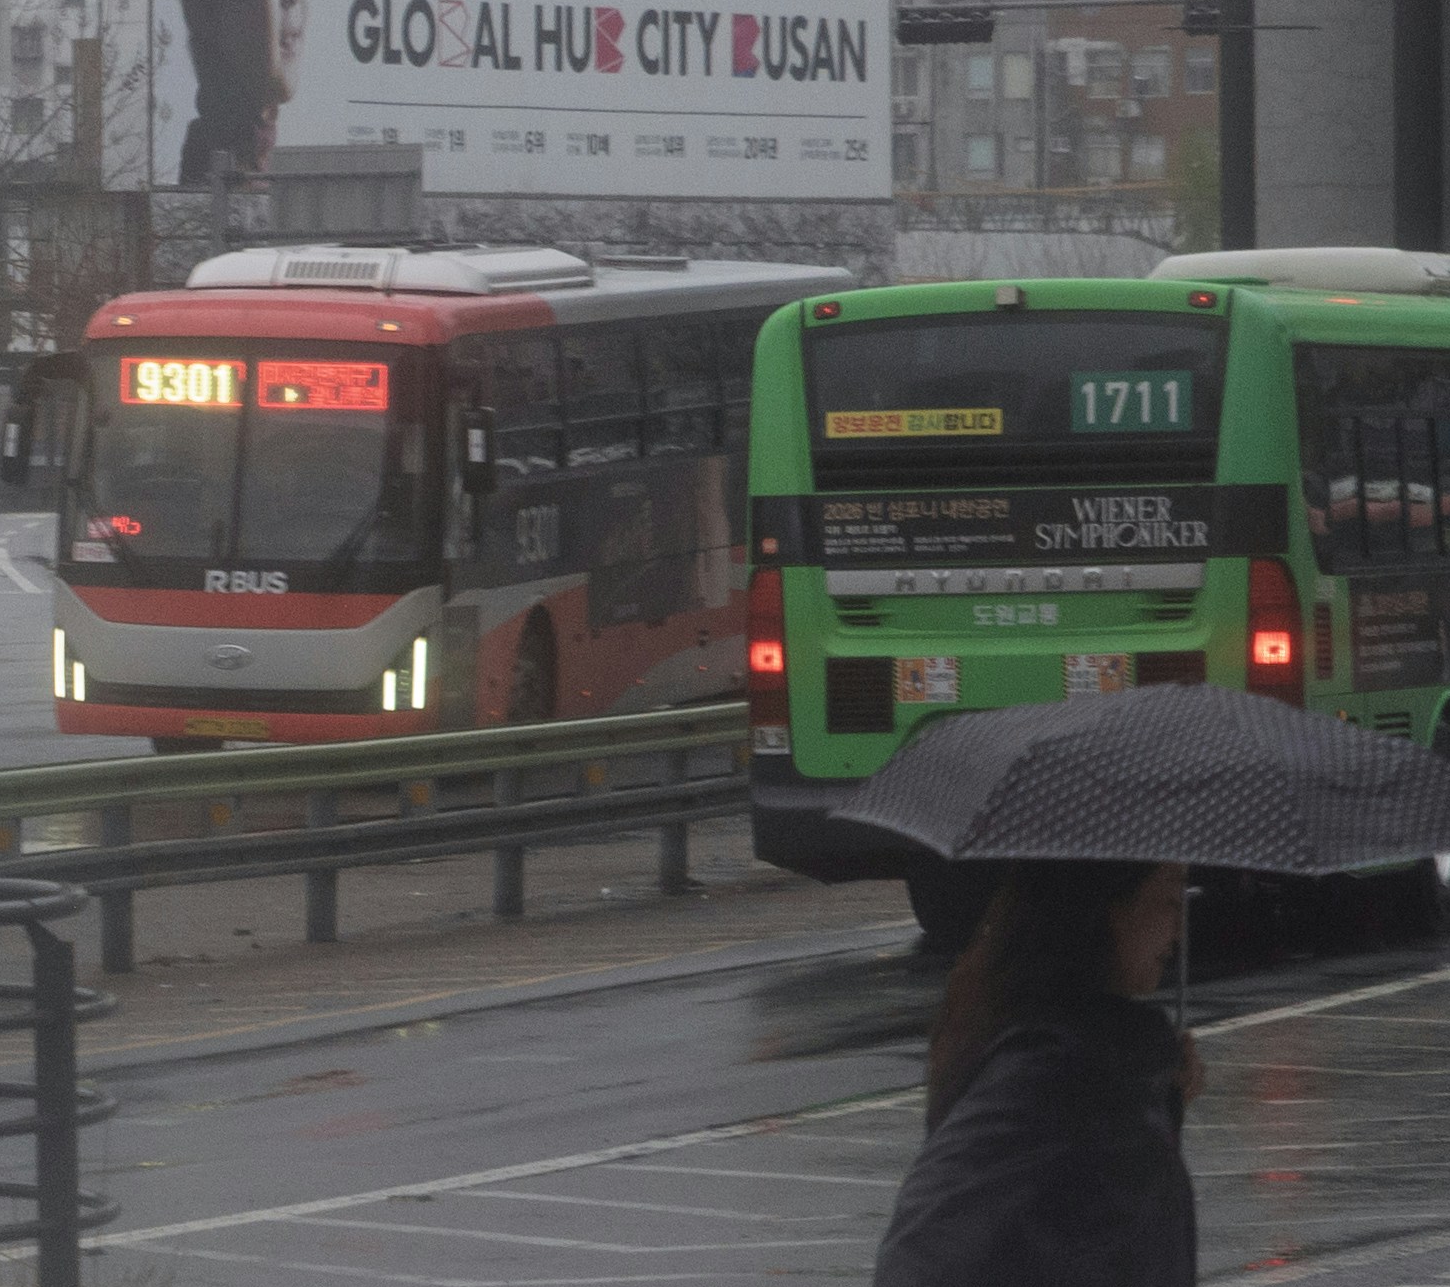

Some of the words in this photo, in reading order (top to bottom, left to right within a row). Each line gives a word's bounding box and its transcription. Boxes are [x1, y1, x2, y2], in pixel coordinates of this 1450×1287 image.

[534, 3, 626, 75] HUB
[636, 7, 721, 74] CITY
[731, 13, 868, 83] BUSAN
[135, 361, 232, 403] 9301
[1081, 381, 1181, 425] 1711
[832, 415, 902, 434] 양보운전
[907, 413, 997, 433] 감사합니다
[887, 500, 938, 521] 심포니
[940, 498, 1011, 519] 내한공연
[1072, 496, 1173, 523] WIENER
[894, 566, 1134, 593] HYUNDAI
[973, 603, 1059, 626] 도원교통
